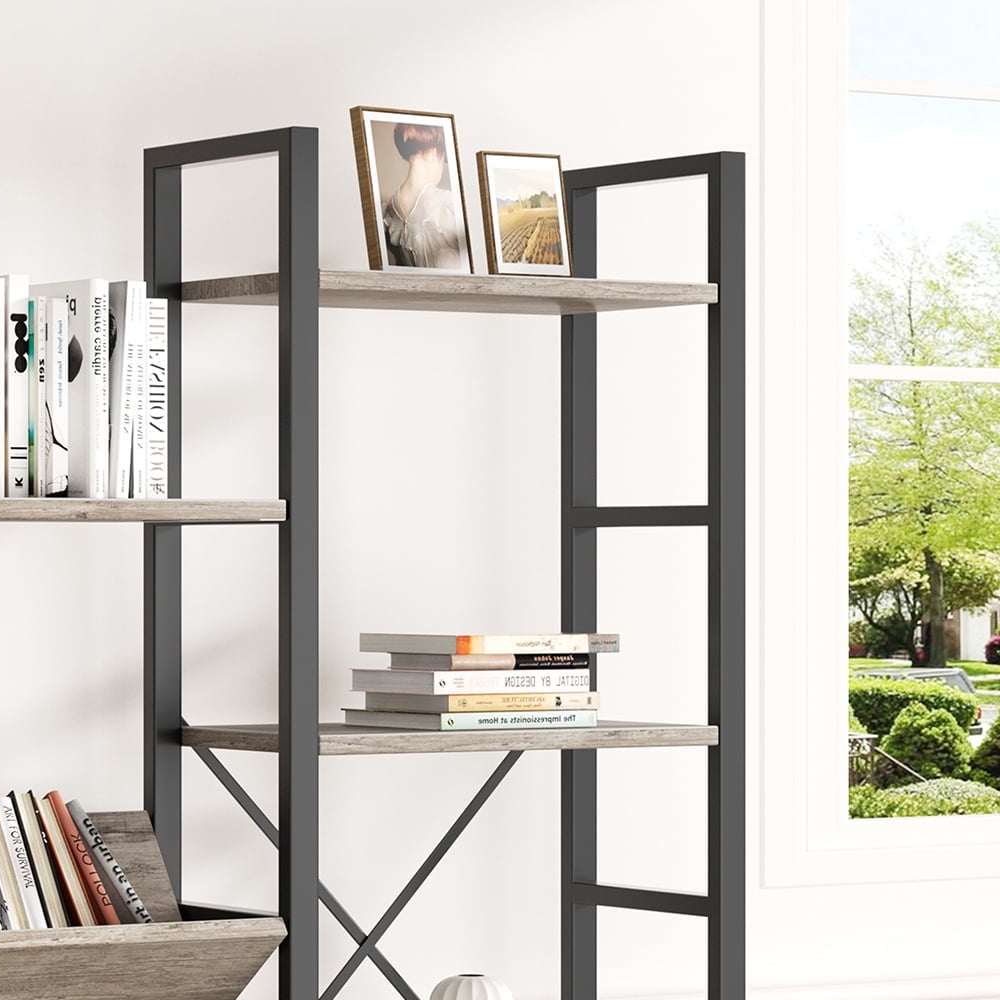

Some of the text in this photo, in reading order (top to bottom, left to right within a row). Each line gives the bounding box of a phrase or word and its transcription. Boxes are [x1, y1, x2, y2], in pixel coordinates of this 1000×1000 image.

[3, 804, 35, 888] ART FOR SURVIVAL
[82, 818, 114, 862] urban
[70, 833, 112, 906] POLLOCK
[112, 865, 127, 884] an
[126, 887, 138, 905] in
